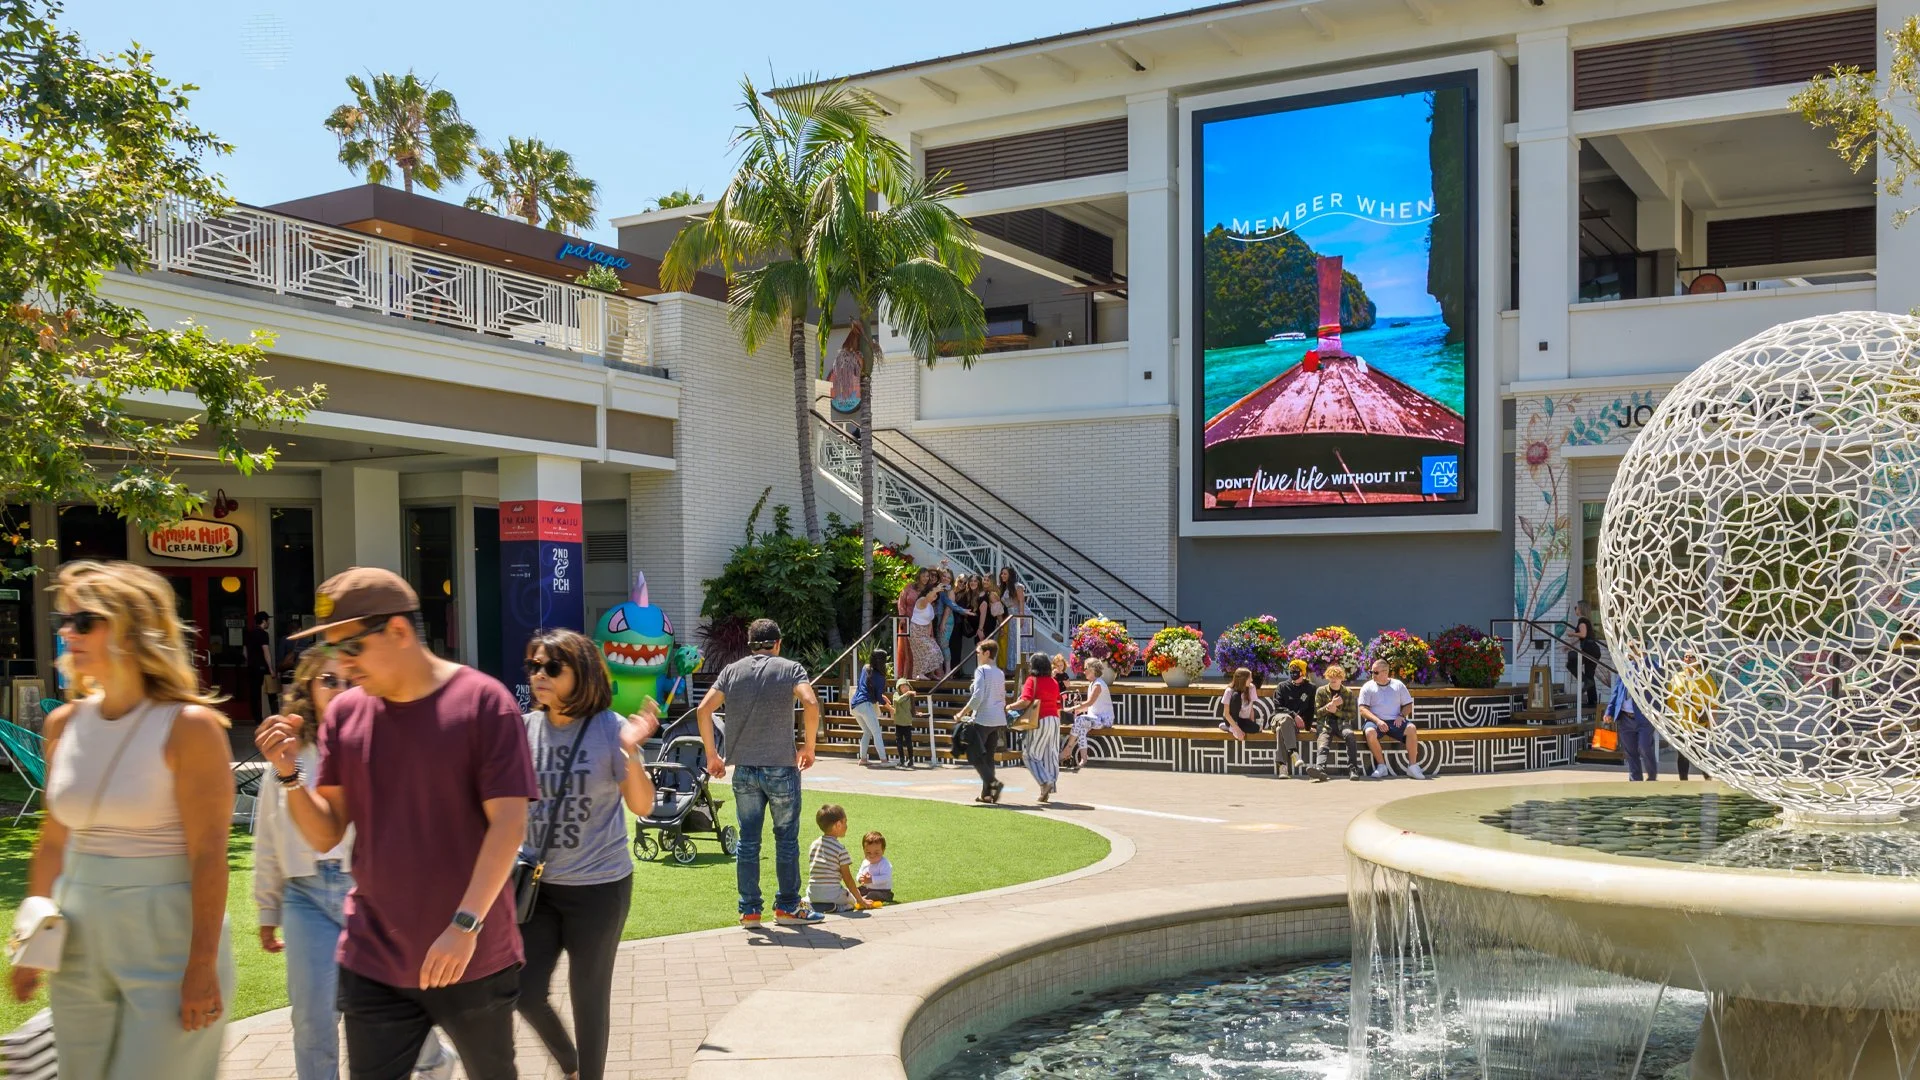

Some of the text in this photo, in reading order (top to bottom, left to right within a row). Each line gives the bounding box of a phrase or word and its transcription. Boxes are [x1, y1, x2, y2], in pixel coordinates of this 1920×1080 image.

[1232, 193, 1434, 236] MEMBER WHEN
[559, 242, 632, 269] palapa
[1216, 478, 1252, 489] DON'T
[1254, 470, 1293, 492] live
[1295, 466, 1329, 494] life
[1331, 472, 1391, 485] WITHOUT
[199, 526, 229, 545] Hills
[167, 543, 222, 553] CREAMERY
[552, 548, 568, 560] 2ND
[554, 558, 569, 578] &
[553, 578, 569, 591] PCH
[515, 684, 530, 696] 2ND
